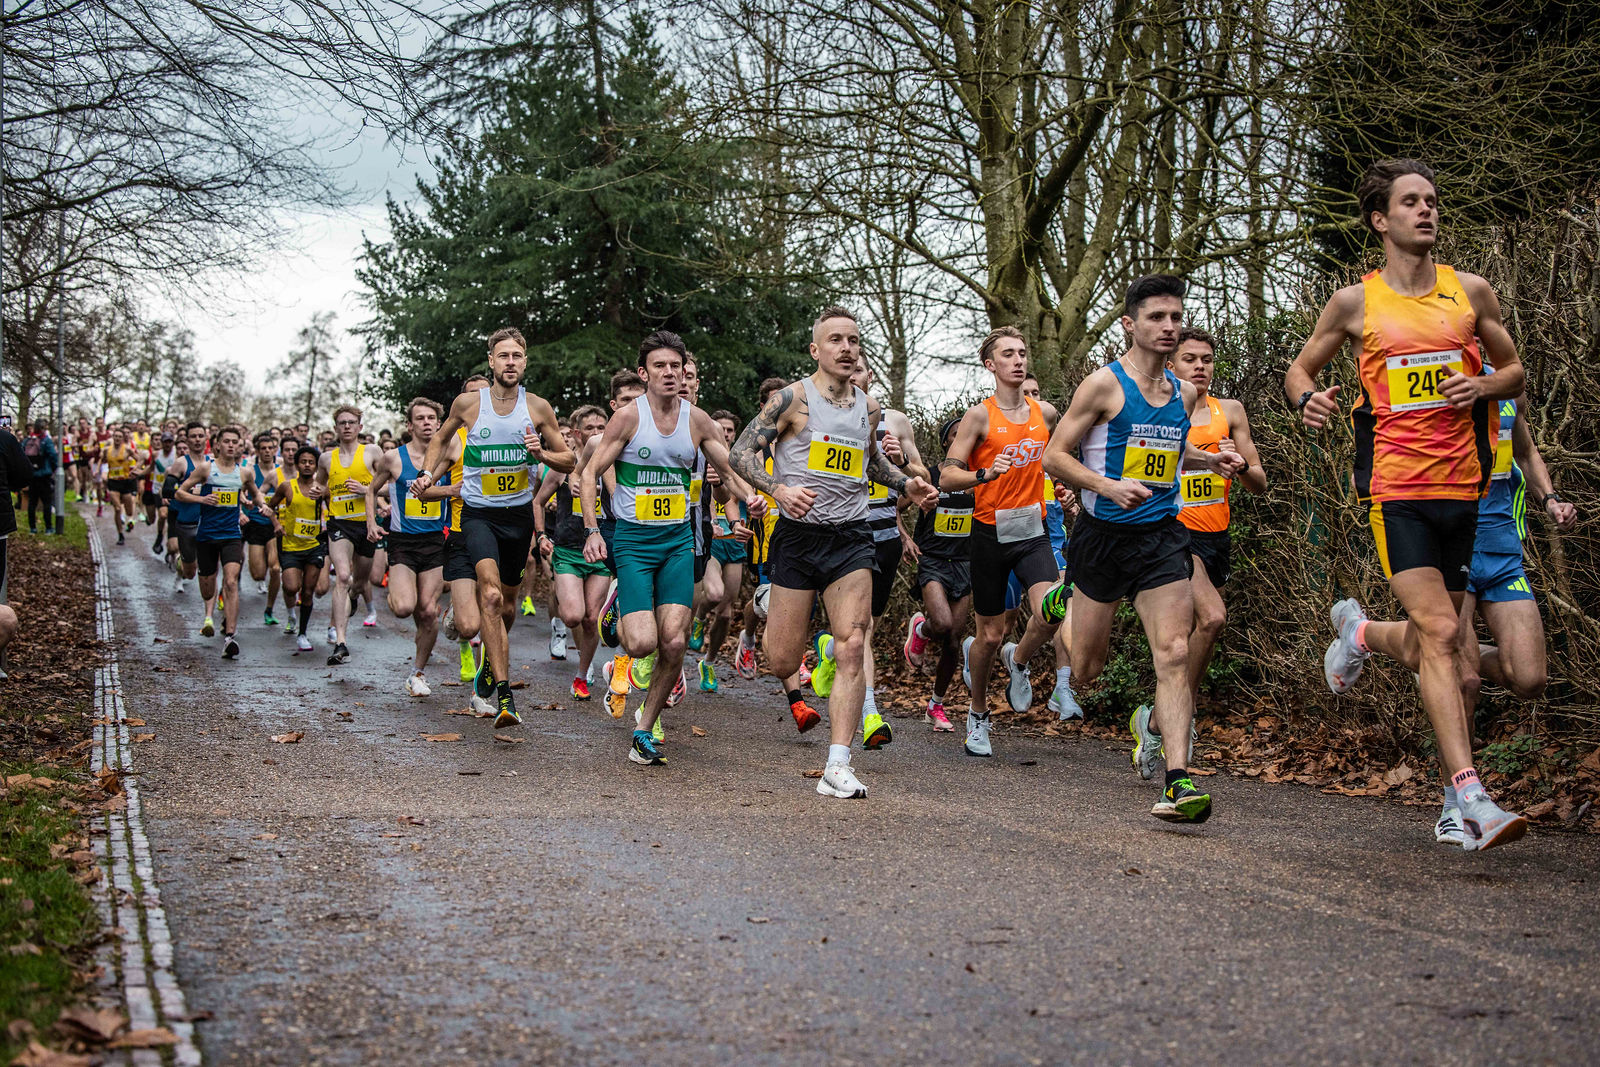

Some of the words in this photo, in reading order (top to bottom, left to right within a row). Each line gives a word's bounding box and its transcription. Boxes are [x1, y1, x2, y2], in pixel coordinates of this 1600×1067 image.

[1407, 369, 1447, 398] 246
[1131, 424, 1182, 439] BEDFORD
[481, 449, 527, 462] MIDLANDS
[825, 447, 851, 471] 218
[1145, 453, 1166, 477] 89
[498, 475, 515, 491] 92
[1187, 477, 1212, 498] 156
[221, 493, 231, 503] 69
[345, 501, 354, 513] 14
[421, 500, 428, 514] 5
[654, 498, 670, 516] 93
[300, 525, 316, 535] 242
[947, 517, 965, 531] 157
[1455, 770, 1477, 784] PUM
